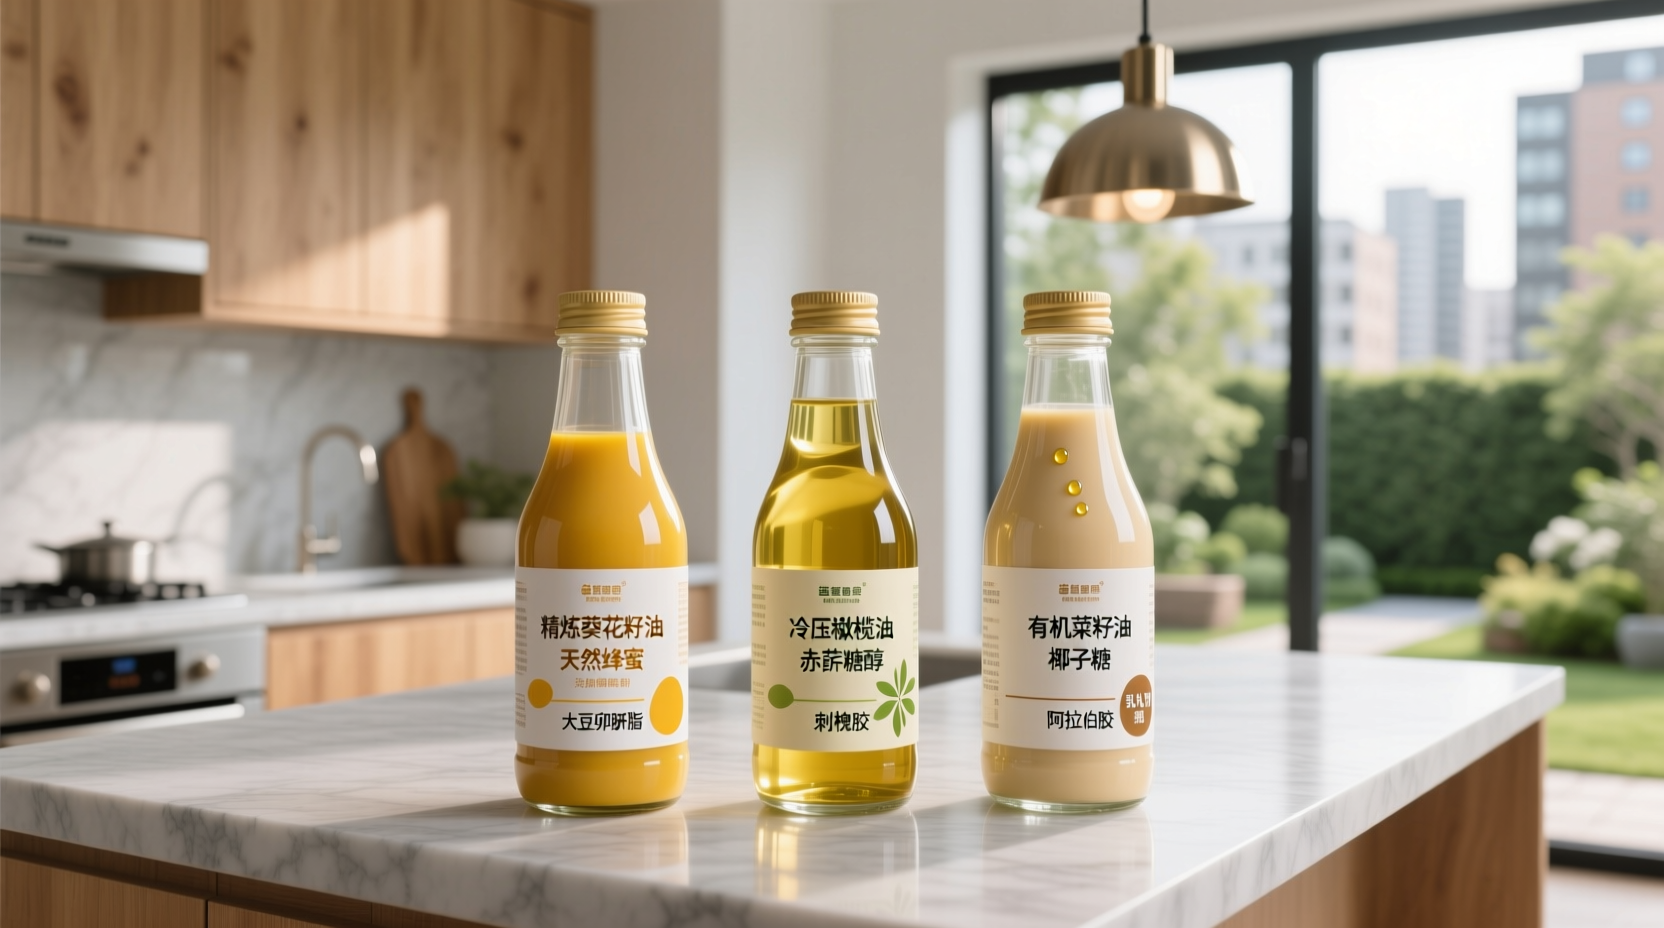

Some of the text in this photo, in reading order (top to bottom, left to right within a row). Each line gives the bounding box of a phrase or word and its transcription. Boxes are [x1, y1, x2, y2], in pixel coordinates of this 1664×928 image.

[1028, 614, 1132, 640] 有机菜籽油
[560, 647, 645, 671] 天然蜂蜜
[1048, 647, 1111, 671] 椰子糖
[1047, 710, 1115, 730] 阿拉伯胶
